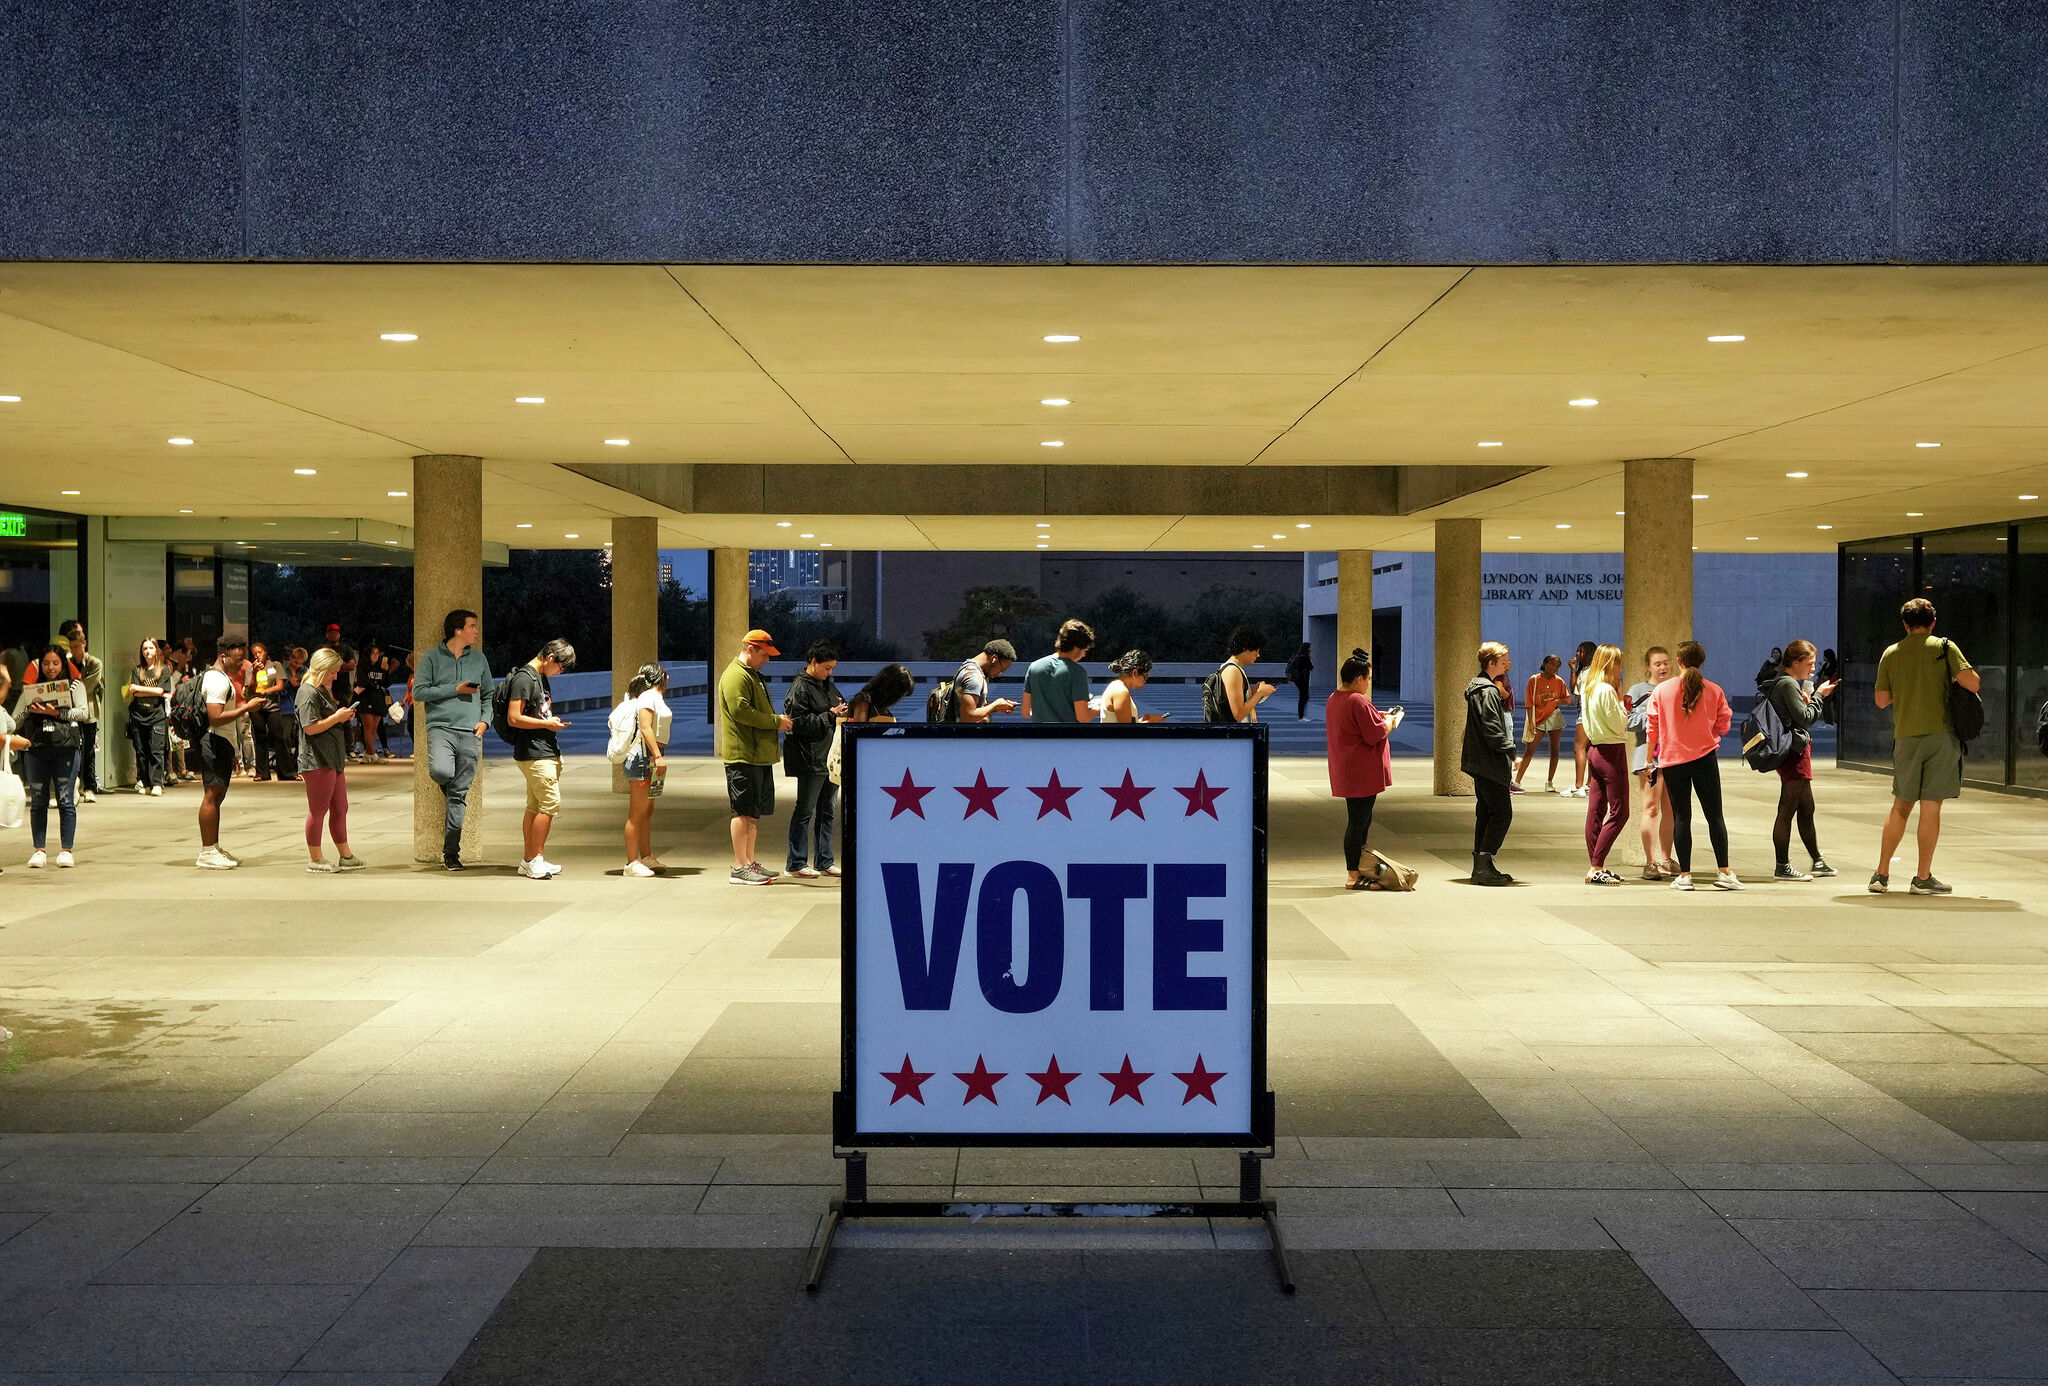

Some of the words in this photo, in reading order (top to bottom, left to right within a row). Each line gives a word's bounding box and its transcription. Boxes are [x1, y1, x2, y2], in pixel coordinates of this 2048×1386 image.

[0, 517, 24, 535] EXIT
[1483, 573, 1538, 584] LYNDON
[1545, 573, 1593, 584] BAINES
[1540, 589, 1568, 600] AND
[1576, 589, 1623, 600] MUSEU
[880, 860, 1228, 1014] VOTE
